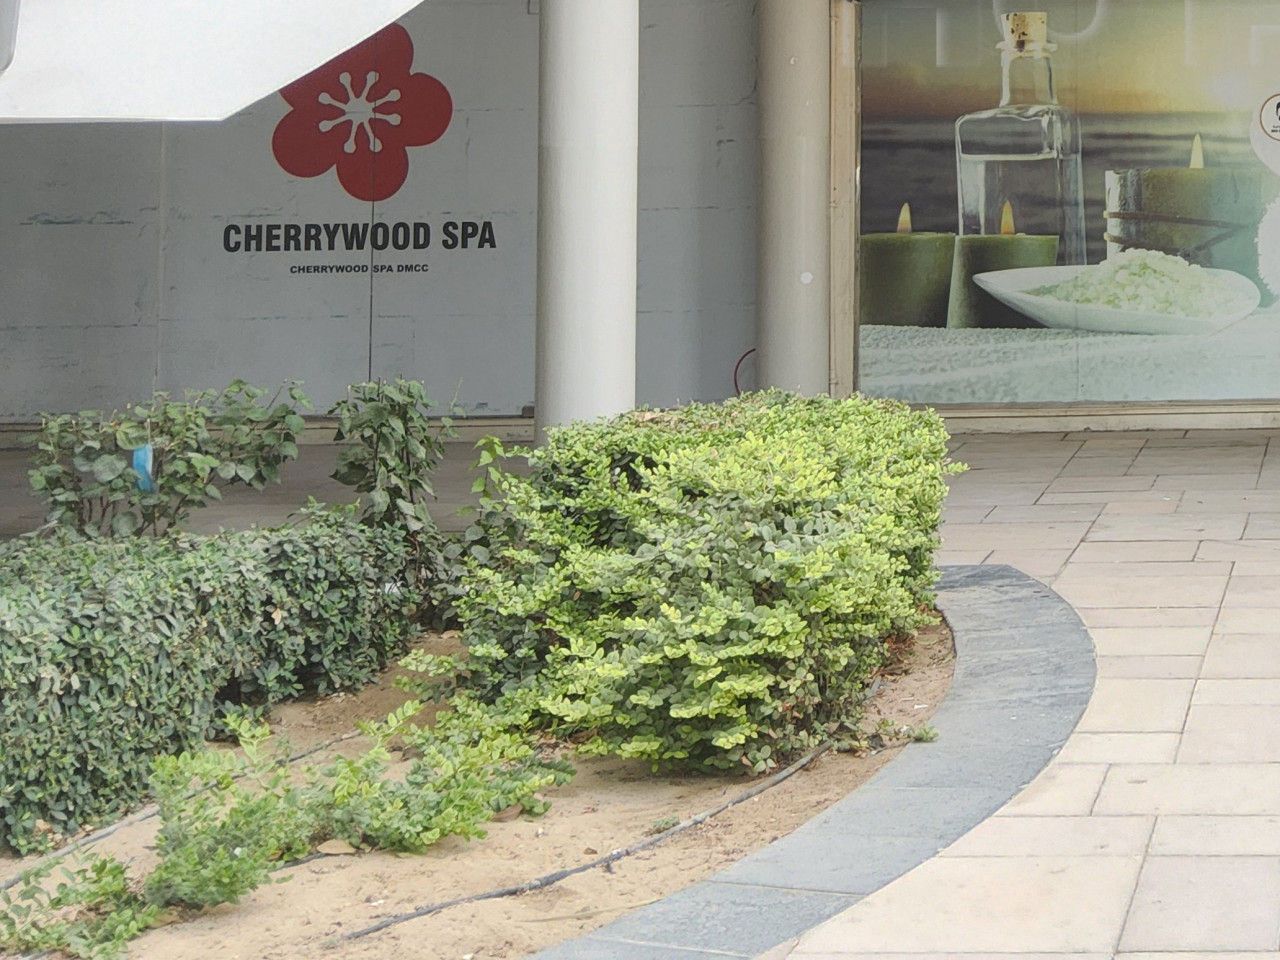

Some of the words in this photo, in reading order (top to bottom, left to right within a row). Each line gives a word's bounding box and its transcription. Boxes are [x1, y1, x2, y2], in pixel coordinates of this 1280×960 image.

[223, 222, 431, 253] CHERRYWOOD
[441, 221, 497, 250] SPA
[290, 264, 368, 274] CHERRYWOOD
[373, 264, 394, 273] SPA
[397, 264, 429, 273] DMCC
